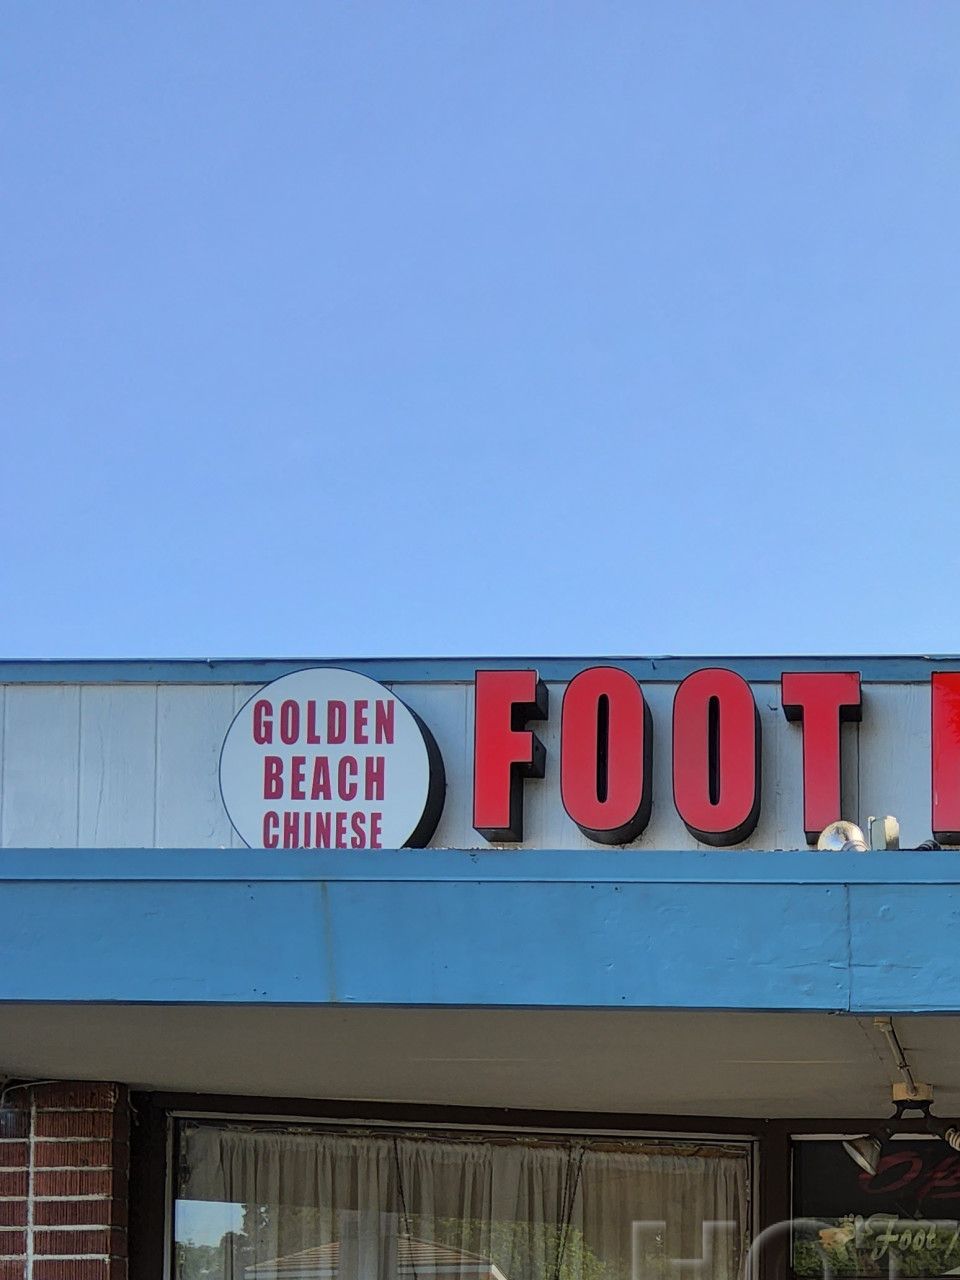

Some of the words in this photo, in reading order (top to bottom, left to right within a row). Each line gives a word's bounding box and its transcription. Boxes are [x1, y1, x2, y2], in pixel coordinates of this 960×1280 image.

[252, 698, 395, 745] GOLDEN
[472, 665, 862, 842] FOOT
[263, 755, 385, 802] BEACH
[262, 810, 382, 849] CHINESE
[866, 1213, 936, 1260] Foot
